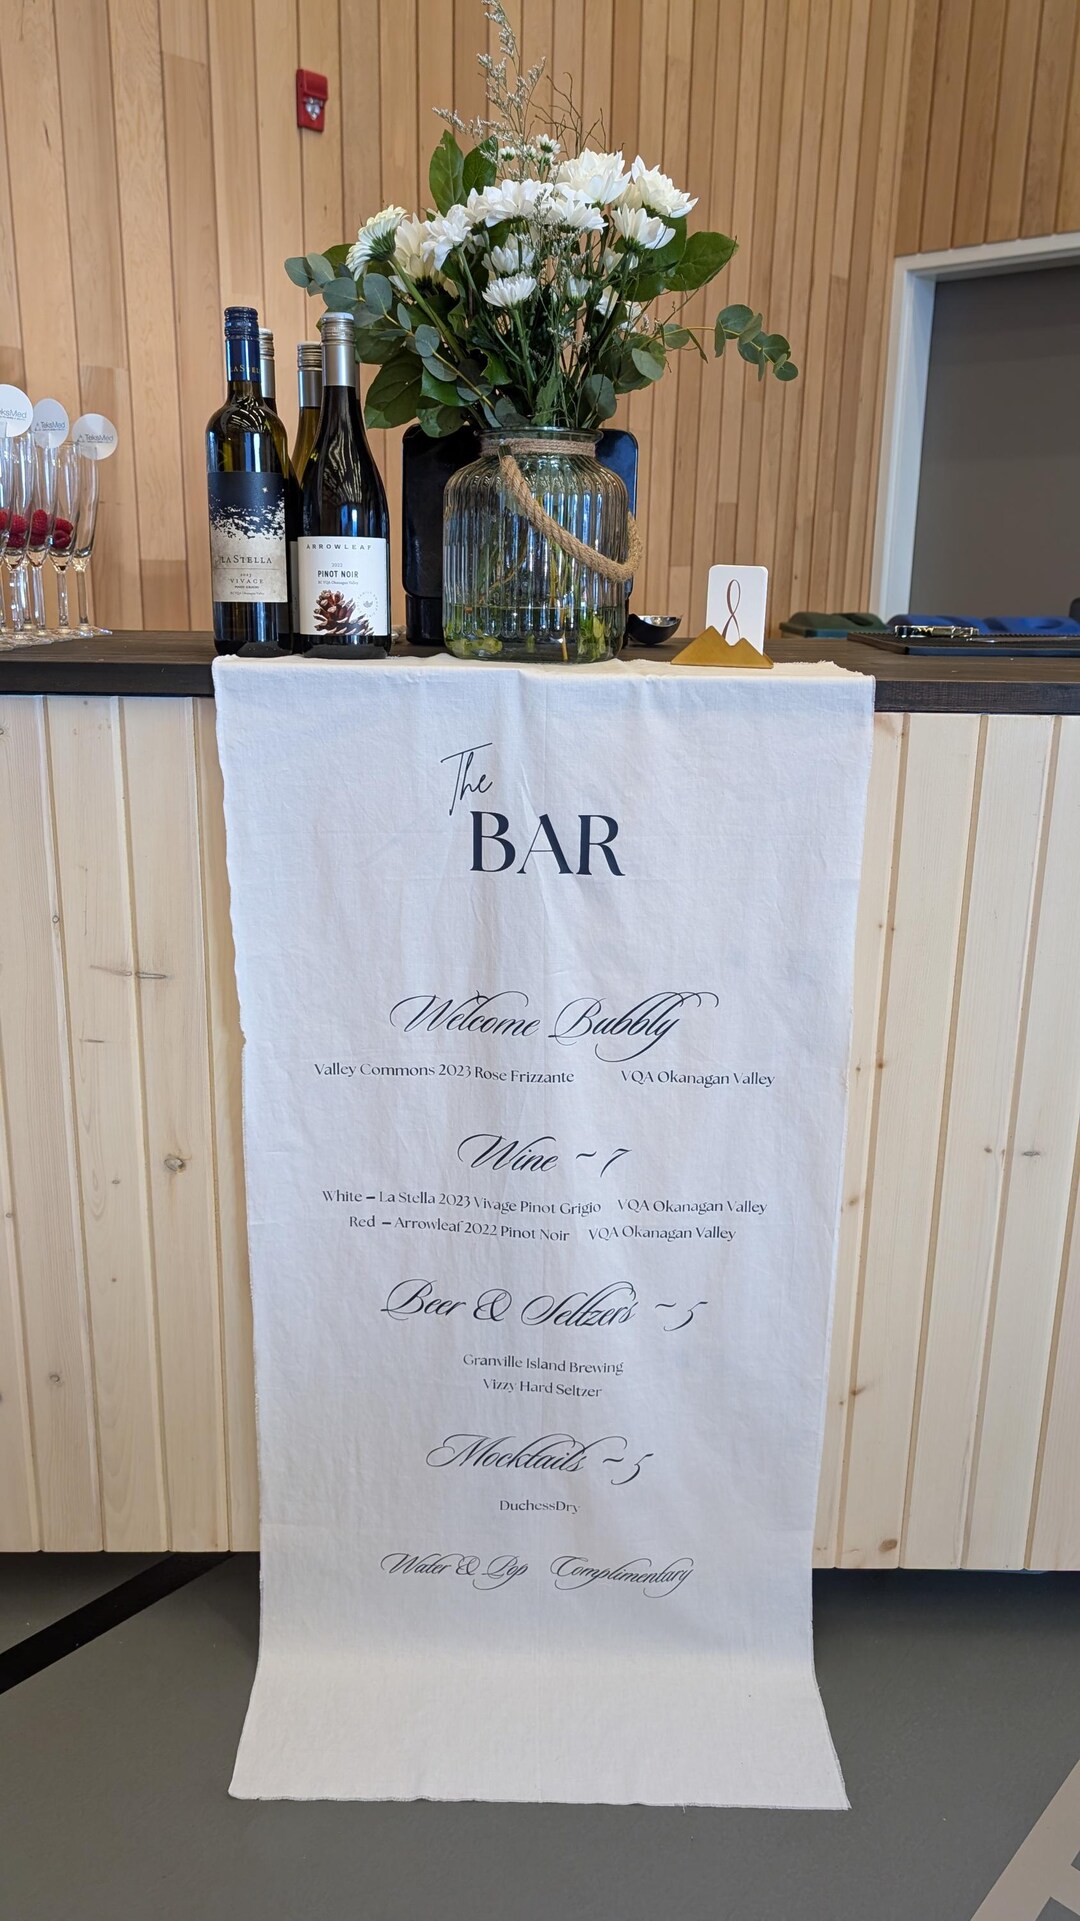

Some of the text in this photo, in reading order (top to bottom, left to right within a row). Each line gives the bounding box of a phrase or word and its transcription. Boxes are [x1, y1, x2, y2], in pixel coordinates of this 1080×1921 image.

[40, 421, 66, 430] TeksMed
[84, 433, 114, 442] TeksMed
[306, 543, 372, 551] ARROWLEAF
[317, 570, 359, 578] PINOT NOIR
[440, 742, 493, 816] The
[470, 810, 626, 877] BAR
[389, 989, 719, 1063] Welcome Bubbly
[314, 1062, 776, 1089] Valley Commons 2023 Rose Frizzante VQA Okanagan Valley
[457, 1133, 559, 1172] Wine
[321, 1189, 364, 1203] White
[379, 1190, 396, 1204] La
[398, 1191, 436, 1205] Stella
[438, 1192, 471, 1209] 2023
[473, 1196, 518, 1215] Vivage
[520, 1200, 556, 1214] Pinot
[559, 1202, 602, 1218] Grigio
[617, 1198, 650, 1214] VQA
[652, 1199, 724, 1216] Okanagan
[726, 1200, 768, 1215] Valley
[349, 1215, 376, 1228] Red
[394, 1216, 462, 1233] Arrowleaf
[464, 1221, 498, 1236] 2022
[500, 1225, 536, 1239] Pinot
[539, 1228, 570, 1242] Noir
[588, 1226, 620, 1242] VQA
[621, 1225, 693, 1243] Okanagan
[695, 1226, 737, 1243] Valley
[380, 1278, 467, 1321] Beer
[473, 1288, 512, 1322] &
[520, 1280, 640, 1328] Seltzers
[463, 1353, 625, 1375] Granville Island Brewing
[482, 1378, 603, 1398] Vizzy Hard Seltzer
[425, 1433, 628, 1472] Mocktails
[499, 1500, 581, 1515] DuchessDry
[381, 1552, 694, 1599] Water & Pop Complimentary
